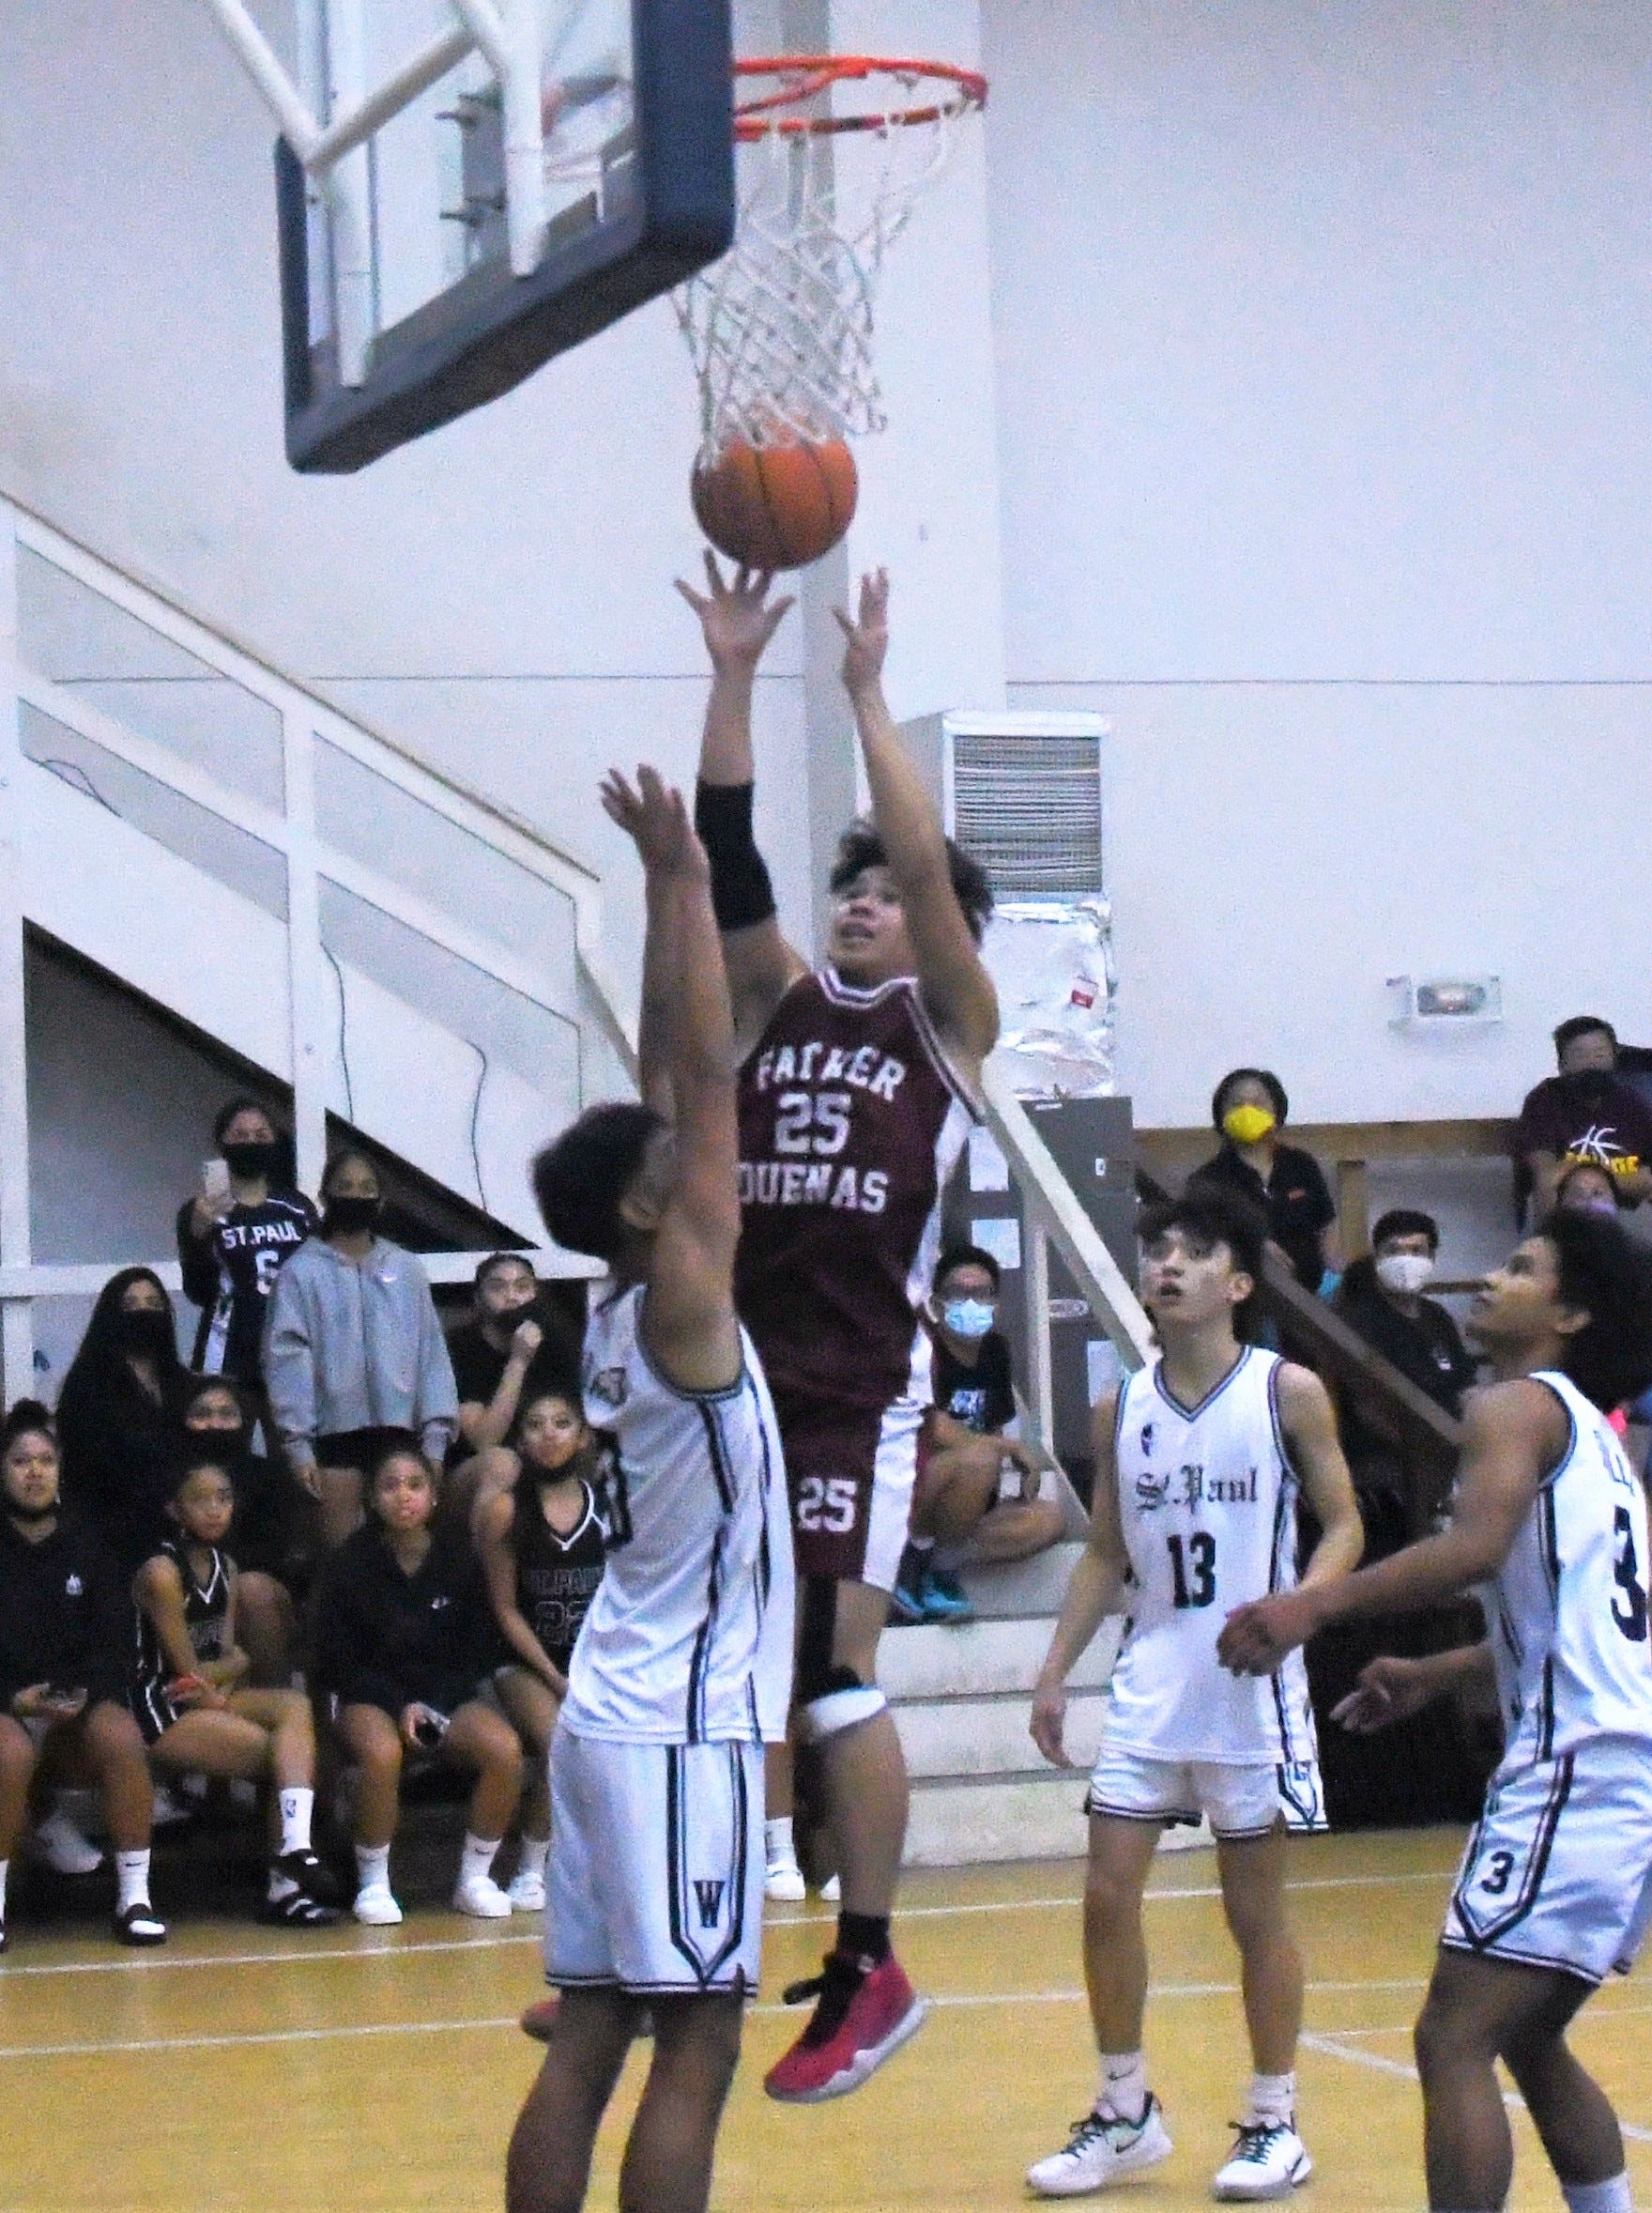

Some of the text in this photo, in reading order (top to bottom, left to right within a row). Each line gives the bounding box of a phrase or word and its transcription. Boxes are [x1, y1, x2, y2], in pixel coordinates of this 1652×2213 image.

[775, 1092, 851, 1155] 25
[799, 1477, 857, 1531] 25
[1167, 1532, 1216, 1608] 13
[1611, 1505, 1646, 1641] 3
[1481, 1852, 1514, 1894] 3
[694, 1880, 725, 1928] W
